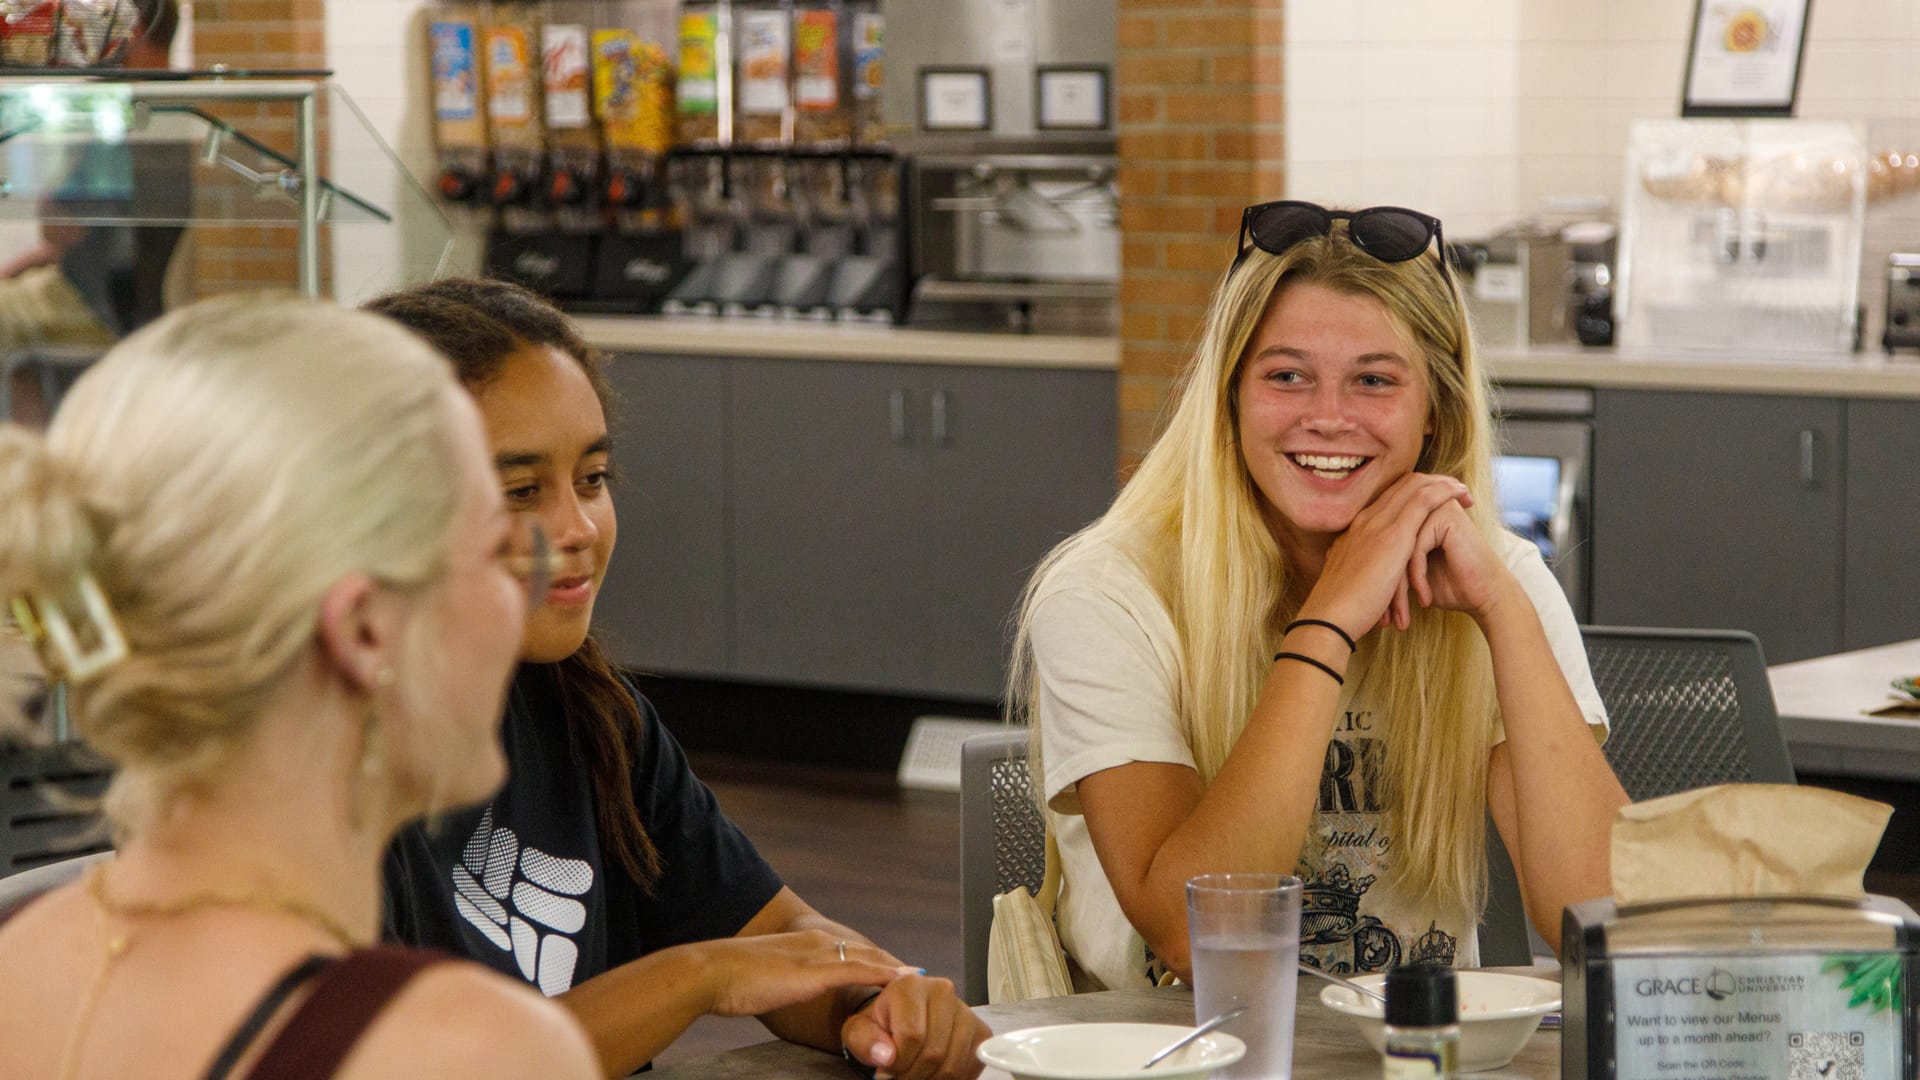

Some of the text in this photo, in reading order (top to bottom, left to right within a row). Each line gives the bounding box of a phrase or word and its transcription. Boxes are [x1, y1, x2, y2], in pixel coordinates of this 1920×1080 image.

[1335, 711, 1373, 732] IC
[1321, 827, 1377, 857] pital
[1635, 977, 1702, 997] GRACE
[1738, 975, 1805, 985] CHRISTIAN
[1738, 983, 1805, 993] UNIVERSITY
[1627, 1011, 1782, 1027] Want to view our Menus
[1639, 1030, 1771, 1047] up to a month ahead?
[1657, 1058, 1745, 1071] Scan the QR Code
